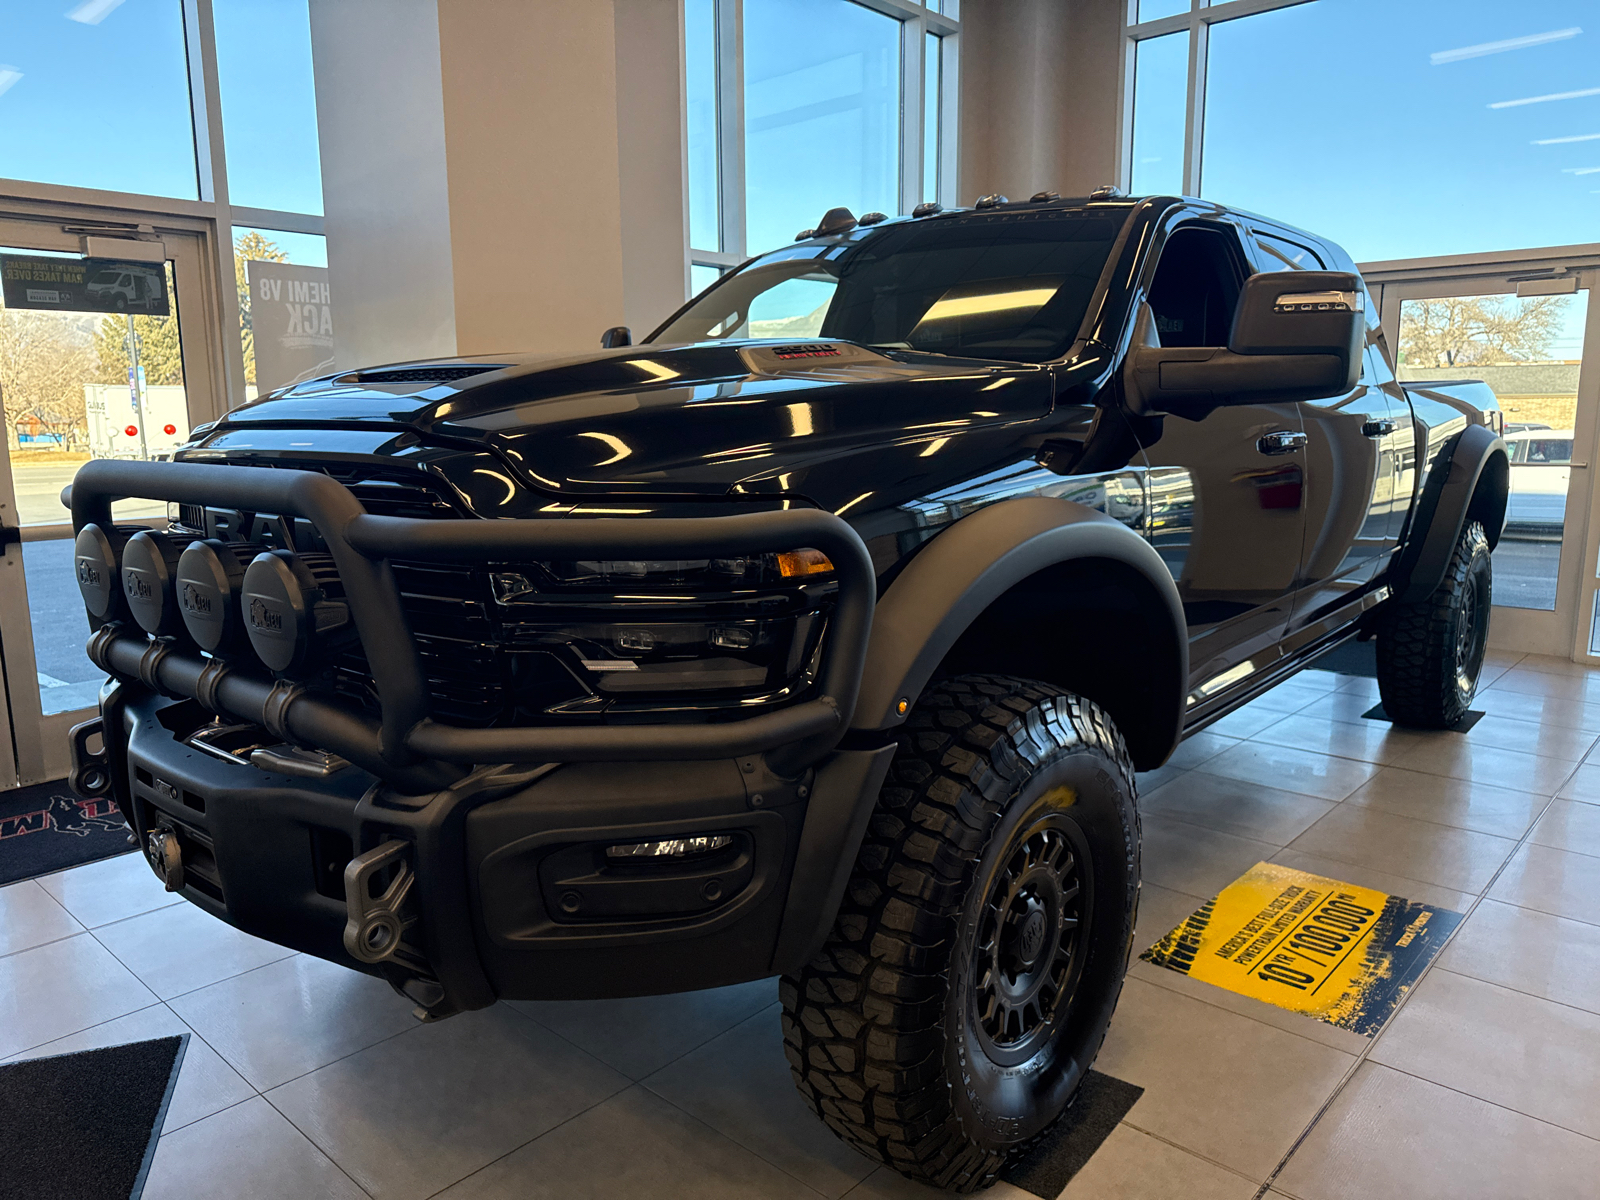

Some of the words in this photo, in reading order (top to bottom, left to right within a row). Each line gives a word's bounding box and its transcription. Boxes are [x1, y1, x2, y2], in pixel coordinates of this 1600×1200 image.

[1215, 931, 1254, 959] AMERICA'S
[1243, 919, 1266, 933] BEST
[1256, 898, 1290, 921] FULL-SIZE
[1279, 885, 1305, 900] TRUCK
[1233, 931, 1278, 965] POWERTRAIN
[1268, 913, 1297, 933] LIMITED
[1288, 890, 1321, 914] WARRANTY
